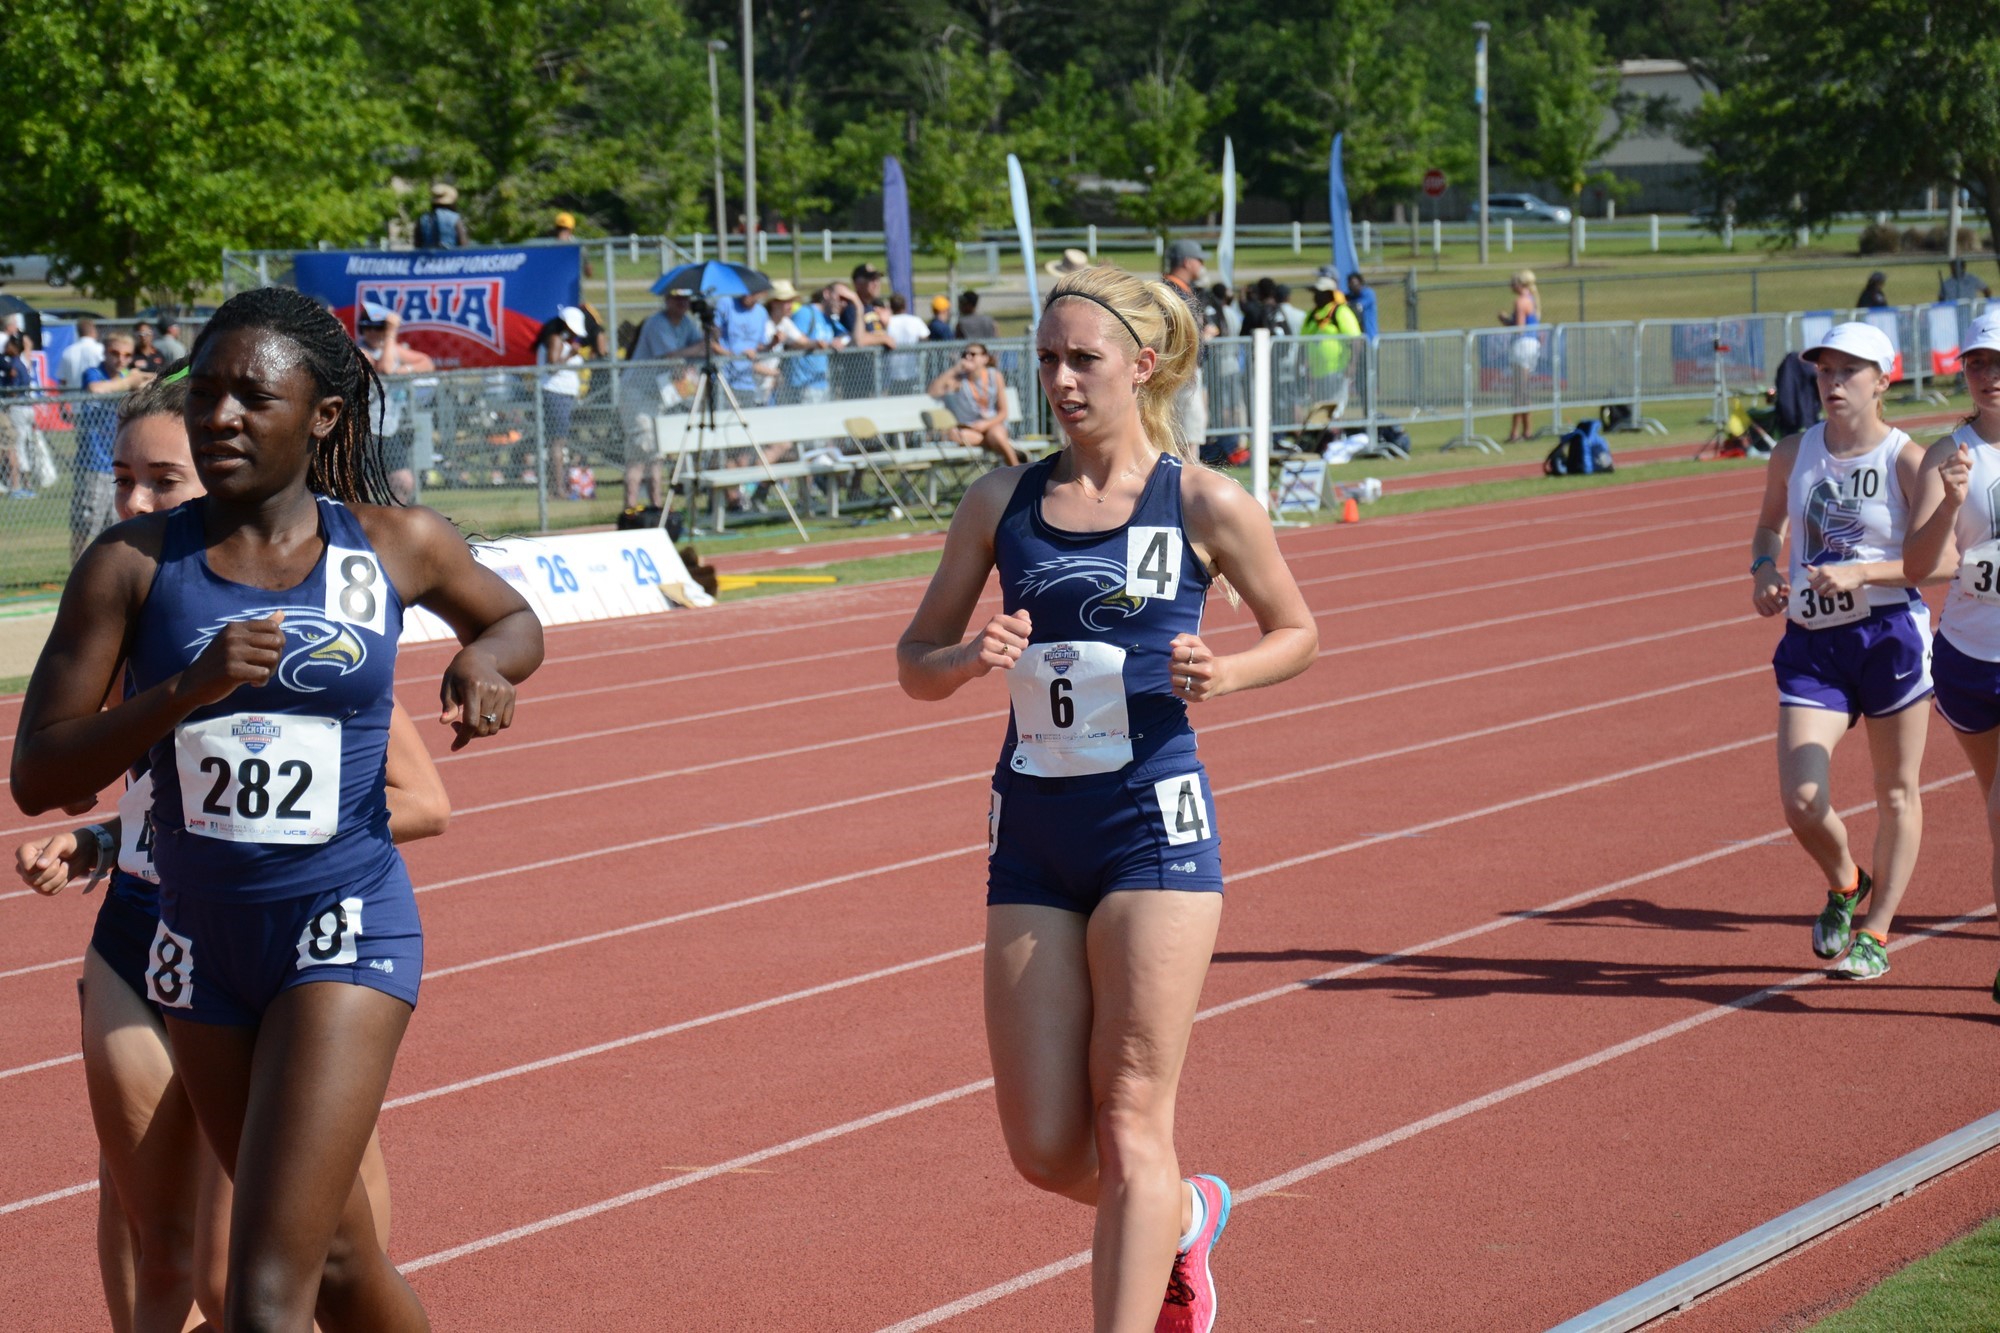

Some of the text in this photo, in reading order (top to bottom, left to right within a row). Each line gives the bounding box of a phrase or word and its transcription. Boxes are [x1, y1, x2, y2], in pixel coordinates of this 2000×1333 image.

[345, 252, 527, 275] NATIONAL CHAMPIONSHIP
[363, 284, 497, 343] NAIA
[1850, 468, 1879, 498] 10
[537, 554, 579, 594] 26
[621, 547, 662, 585] 29
[1137, 531, 1172, 595] 4
[1974, 560, 2000, 595] 3
[339, 554, 377, 623] 8
[1800, 588, 1854, 619] 365
[1050, 678, 1074, 728] 6
[232, 725, 256, 735] TRACK
[260, 726, 280, 737] FIELD
[200, 756, 313, 820] 282
[1175, 780, 1204, 841] 4
[152, 933, 183, 1003] 8
